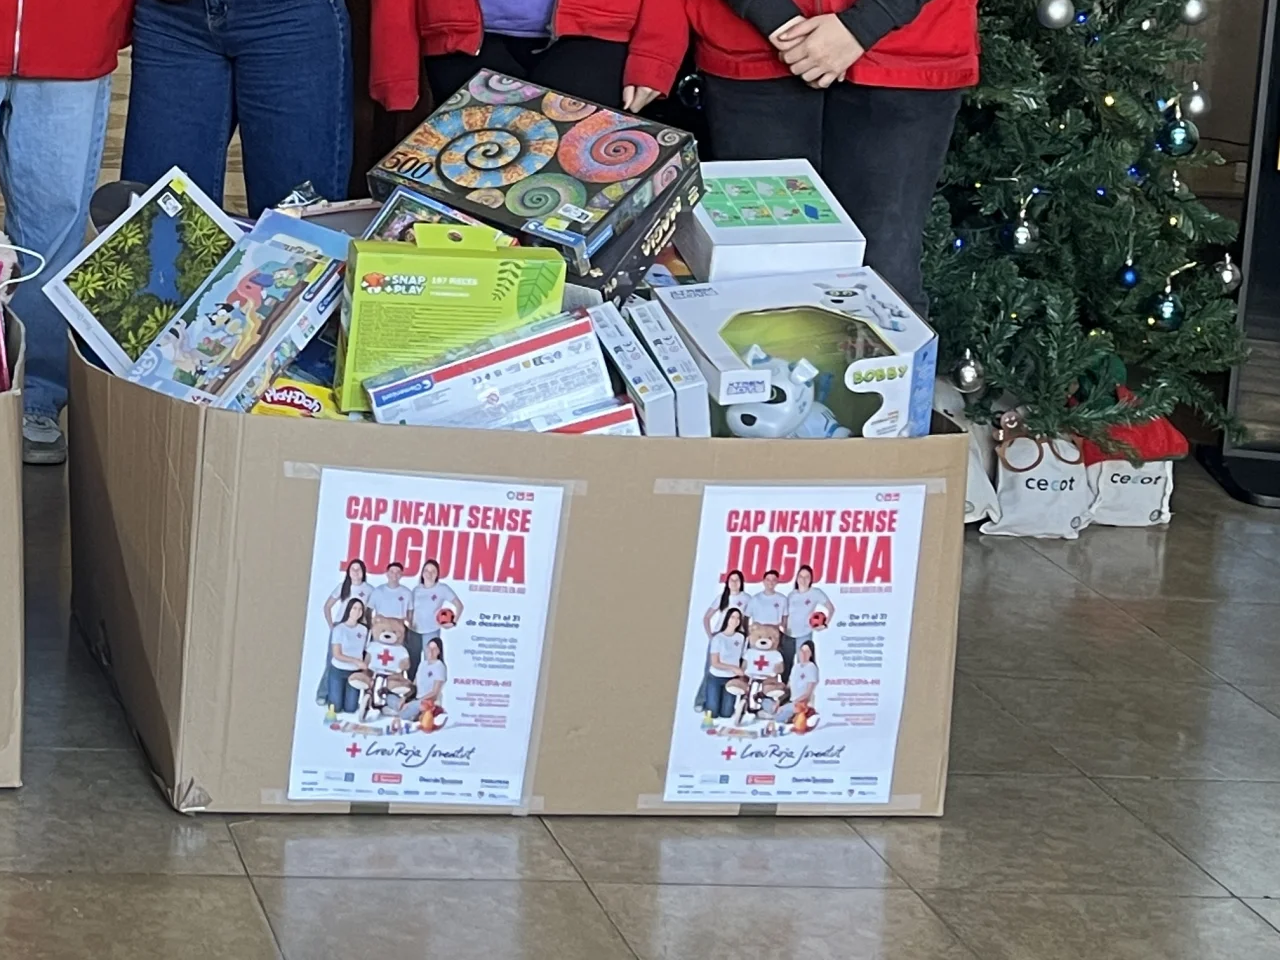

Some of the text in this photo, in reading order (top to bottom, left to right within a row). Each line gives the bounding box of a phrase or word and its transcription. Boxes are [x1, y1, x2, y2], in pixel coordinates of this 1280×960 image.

[382, 152, 434, 179] 500
[391, 275, 426, 285] SNAP
[853, 365, 908, 385] BOBBY
[263, 388, 322, 413] Play-Doh
[1025, 476, 1075, 492] cecot
[346, 495, 532, 532] CAP INFANT SENSE
[726, 509, 898, 533] CAP INFANT SENSE
[339, 522, 526, 584] JOGUINA
[718, 535, 893, 584] JOGUINA
[365, 741, 394, 756] Creu
[395, 742, 421, 761] Roja
[740, 744, 768, 759] Creu
[769, 744, 795, 763] Roja
